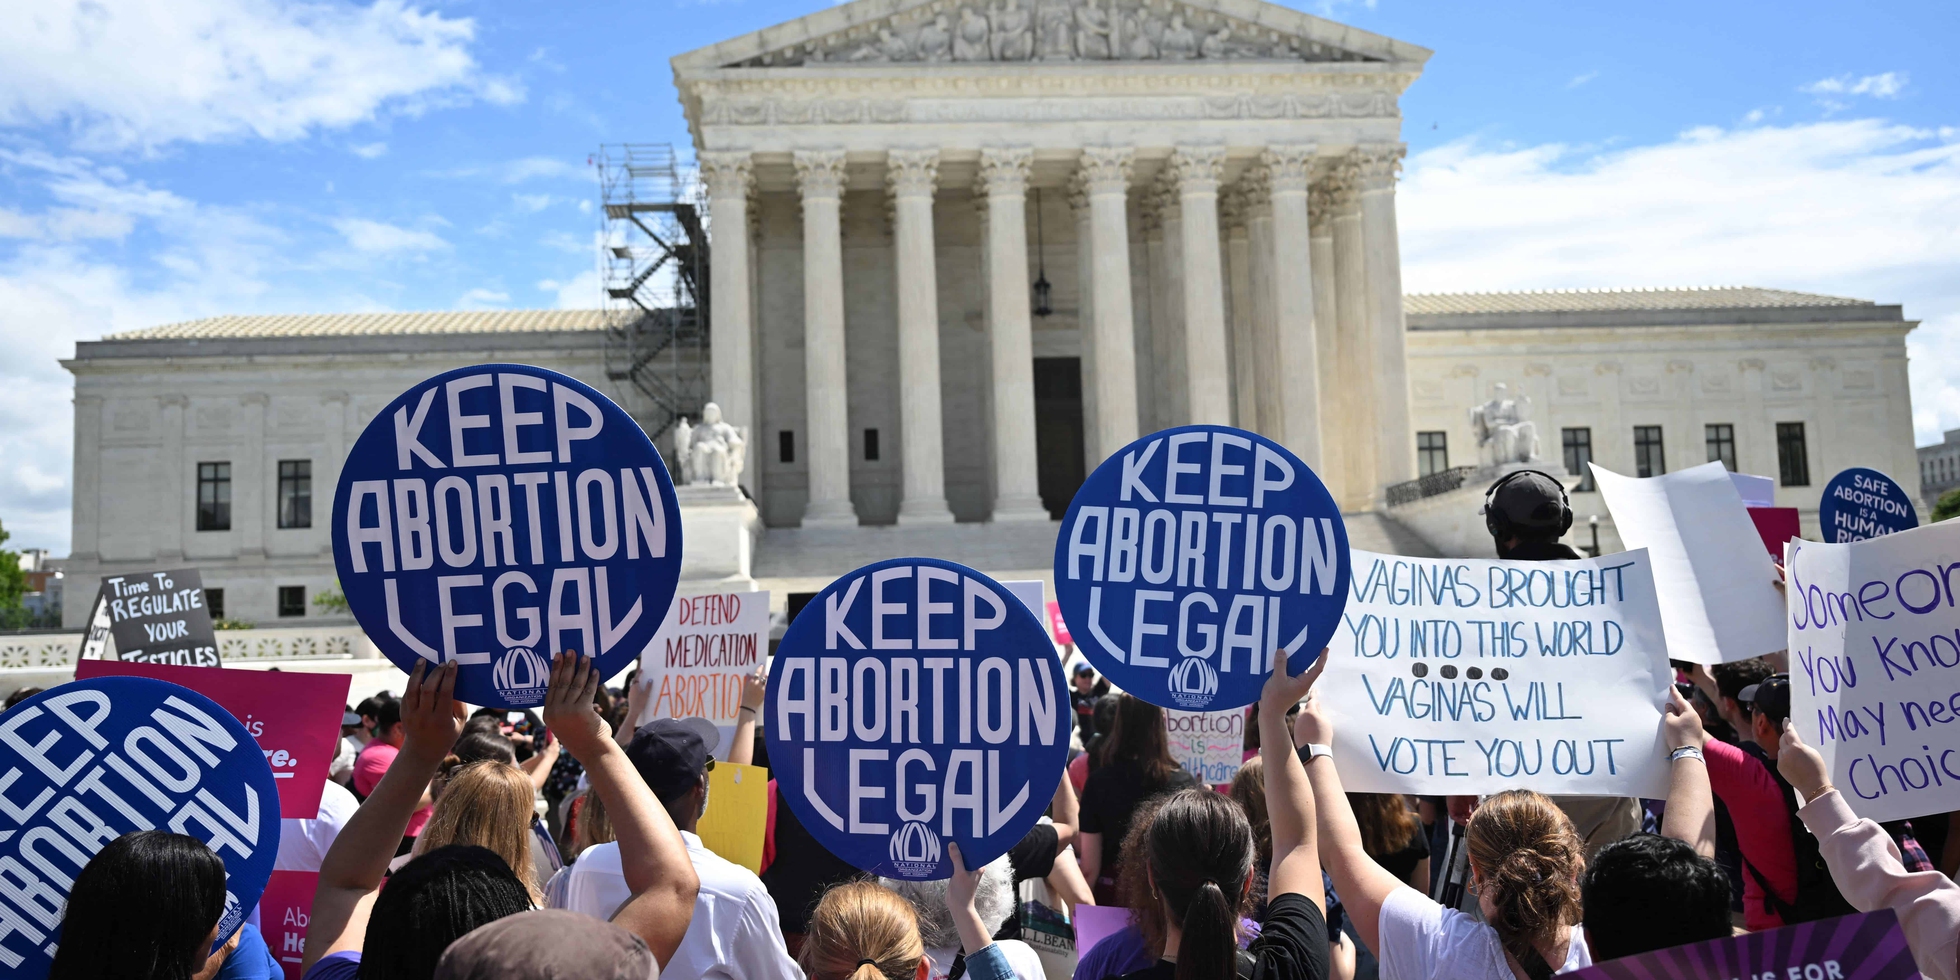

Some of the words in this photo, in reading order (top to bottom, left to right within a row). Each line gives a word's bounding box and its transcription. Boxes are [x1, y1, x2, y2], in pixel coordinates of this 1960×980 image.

[394, 373, 604, 470] KEEP
[1120, 432, 1295, 508] KEEP
[1854, 474, 1889, 496] SAFE
[347, 467, 667, 573] ABORTION
[1834, 485, 1908, 518] ABORTION
[1859, 507, 1869, 518] IS
[1869, 511, 1878, 521] A
[1068, 506, 1338, 596] ABORTION
[108, 577, 150, 598] Time
[153, 572, 174, 591] To
[110, 588, 202, 622] REGULATE
[1350, 559, 1481, 608] VAGINAS
[1489, 562, 1635, 609] BROUGHT
[384, 566, 643, 665] LEGAL
[679, 593, 741, 626] DEFEND
[825, 566, 1007, 650] KEEP
[144, 619, 189, 643] YOUR
[665, 632, 757, 668] MEDICATION
[1088, 586, 1307, 675] LEGAL
[1344, 613, 1400, 659] YOU
[1410, 619, 1462, 658] INTO
[1466, 620, 1528, 658] THIS
[1534, 620, 1625, 656] WORLD
[493, 648, 551, 690] NOW
[1168, 657, 1219, 695] NOW
[777, 656, 1057, 746] ABORTION
[1361, 674, 1495, 722] VAGINAS
[1502, 681, 1582, 721] WILL
[245, 714, 265, 737] is
[1166, 709, 1243, 735] bortion
[0, 689, 111, 842] EEP
[1368, 734, 1469, 777] VOTE
[1475, 737, 1543, 777] YOU
[1552, 738, 1625, 776] OUT
[1849, 745, 1960, 800] Choic
[804, 747, 1030, 838] LEGAL
[889, 822, 941, 862] NOW
[1022, 928, 1074, 951] L.L.BEAN
